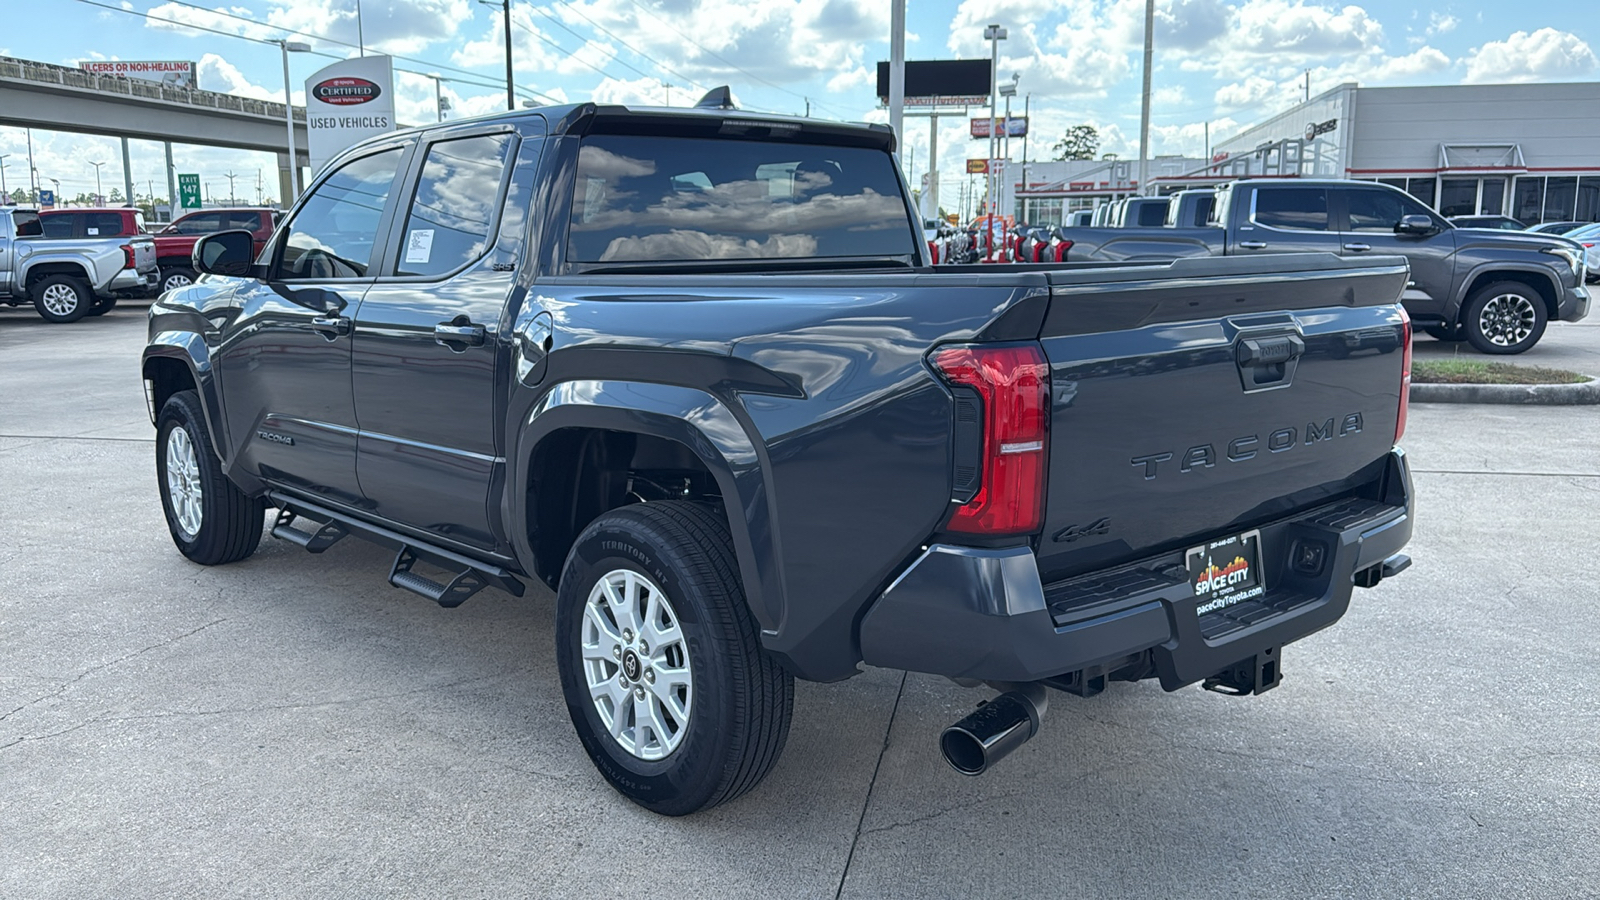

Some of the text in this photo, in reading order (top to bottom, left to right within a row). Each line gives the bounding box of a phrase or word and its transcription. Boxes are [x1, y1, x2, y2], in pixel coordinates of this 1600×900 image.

[81, 62, 189, 72] ULCERS OR NON-HEALING
[320, 86, 372, 96] CERTIFIED
[310, 116, 388, 129] USED VEHICLES
[182, 184, 197, 194] 147
[257, 430, 295, 446] TACOMA
[1130, 411, 1364, 481] TACOMA
[601, 540, 652, 566] TERRITORY
[1195, 566, 1249, 596] SPACE CITY
[1219, 586, 1235, 596] TOYOTA
[1196, 586, 1263, 617] paceCityToyota.com
